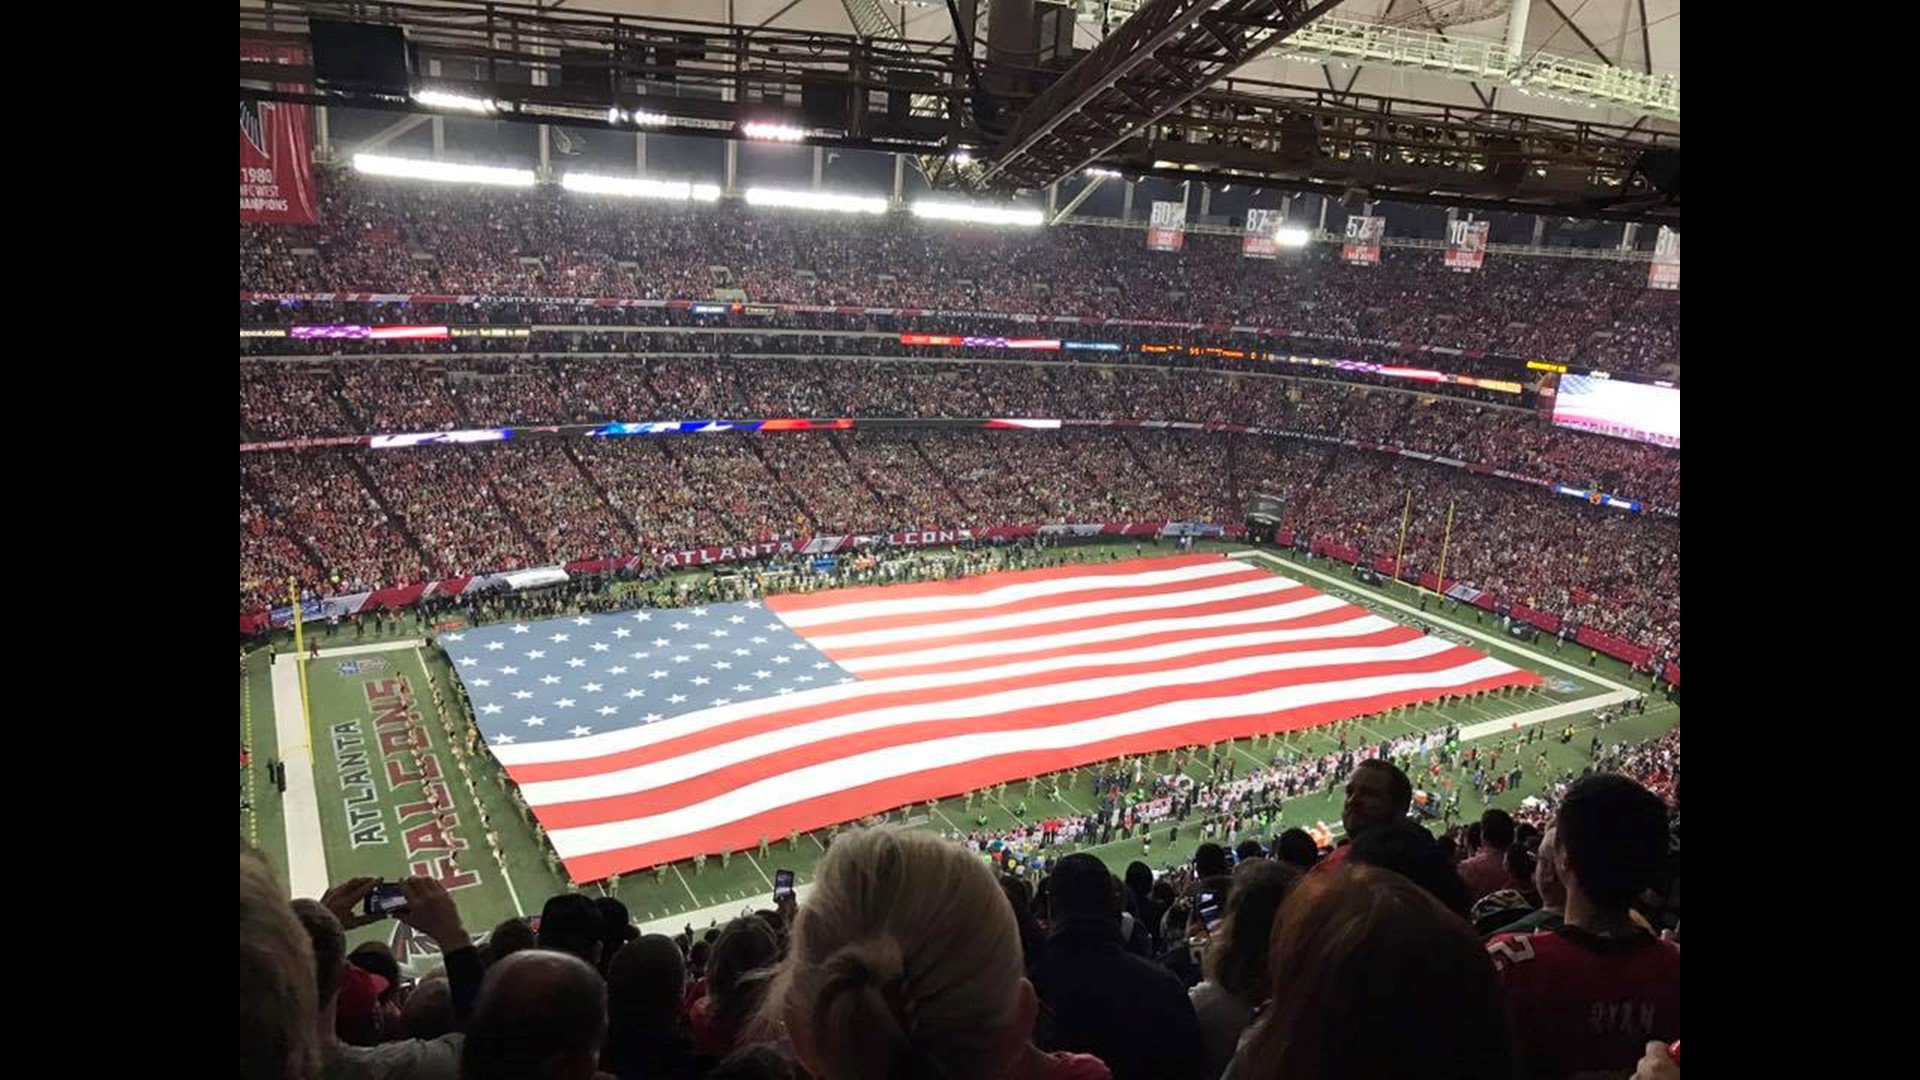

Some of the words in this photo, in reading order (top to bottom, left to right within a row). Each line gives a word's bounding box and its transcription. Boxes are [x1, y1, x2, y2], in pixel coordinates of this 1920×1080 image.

[241, 168, 272, 183] 1980
[240, 198, 288, 211] HAMPIONS
[1152, 201, 1171, 225] 60
[1249, 209, 1267, 231] 87
[1451, 221, 1467, 244] 10
[661, 541, 794, 567] ATLANTA
[331, 717, 390, 850] ATLANTA
[362, 674, 482, 892] FALCONS
